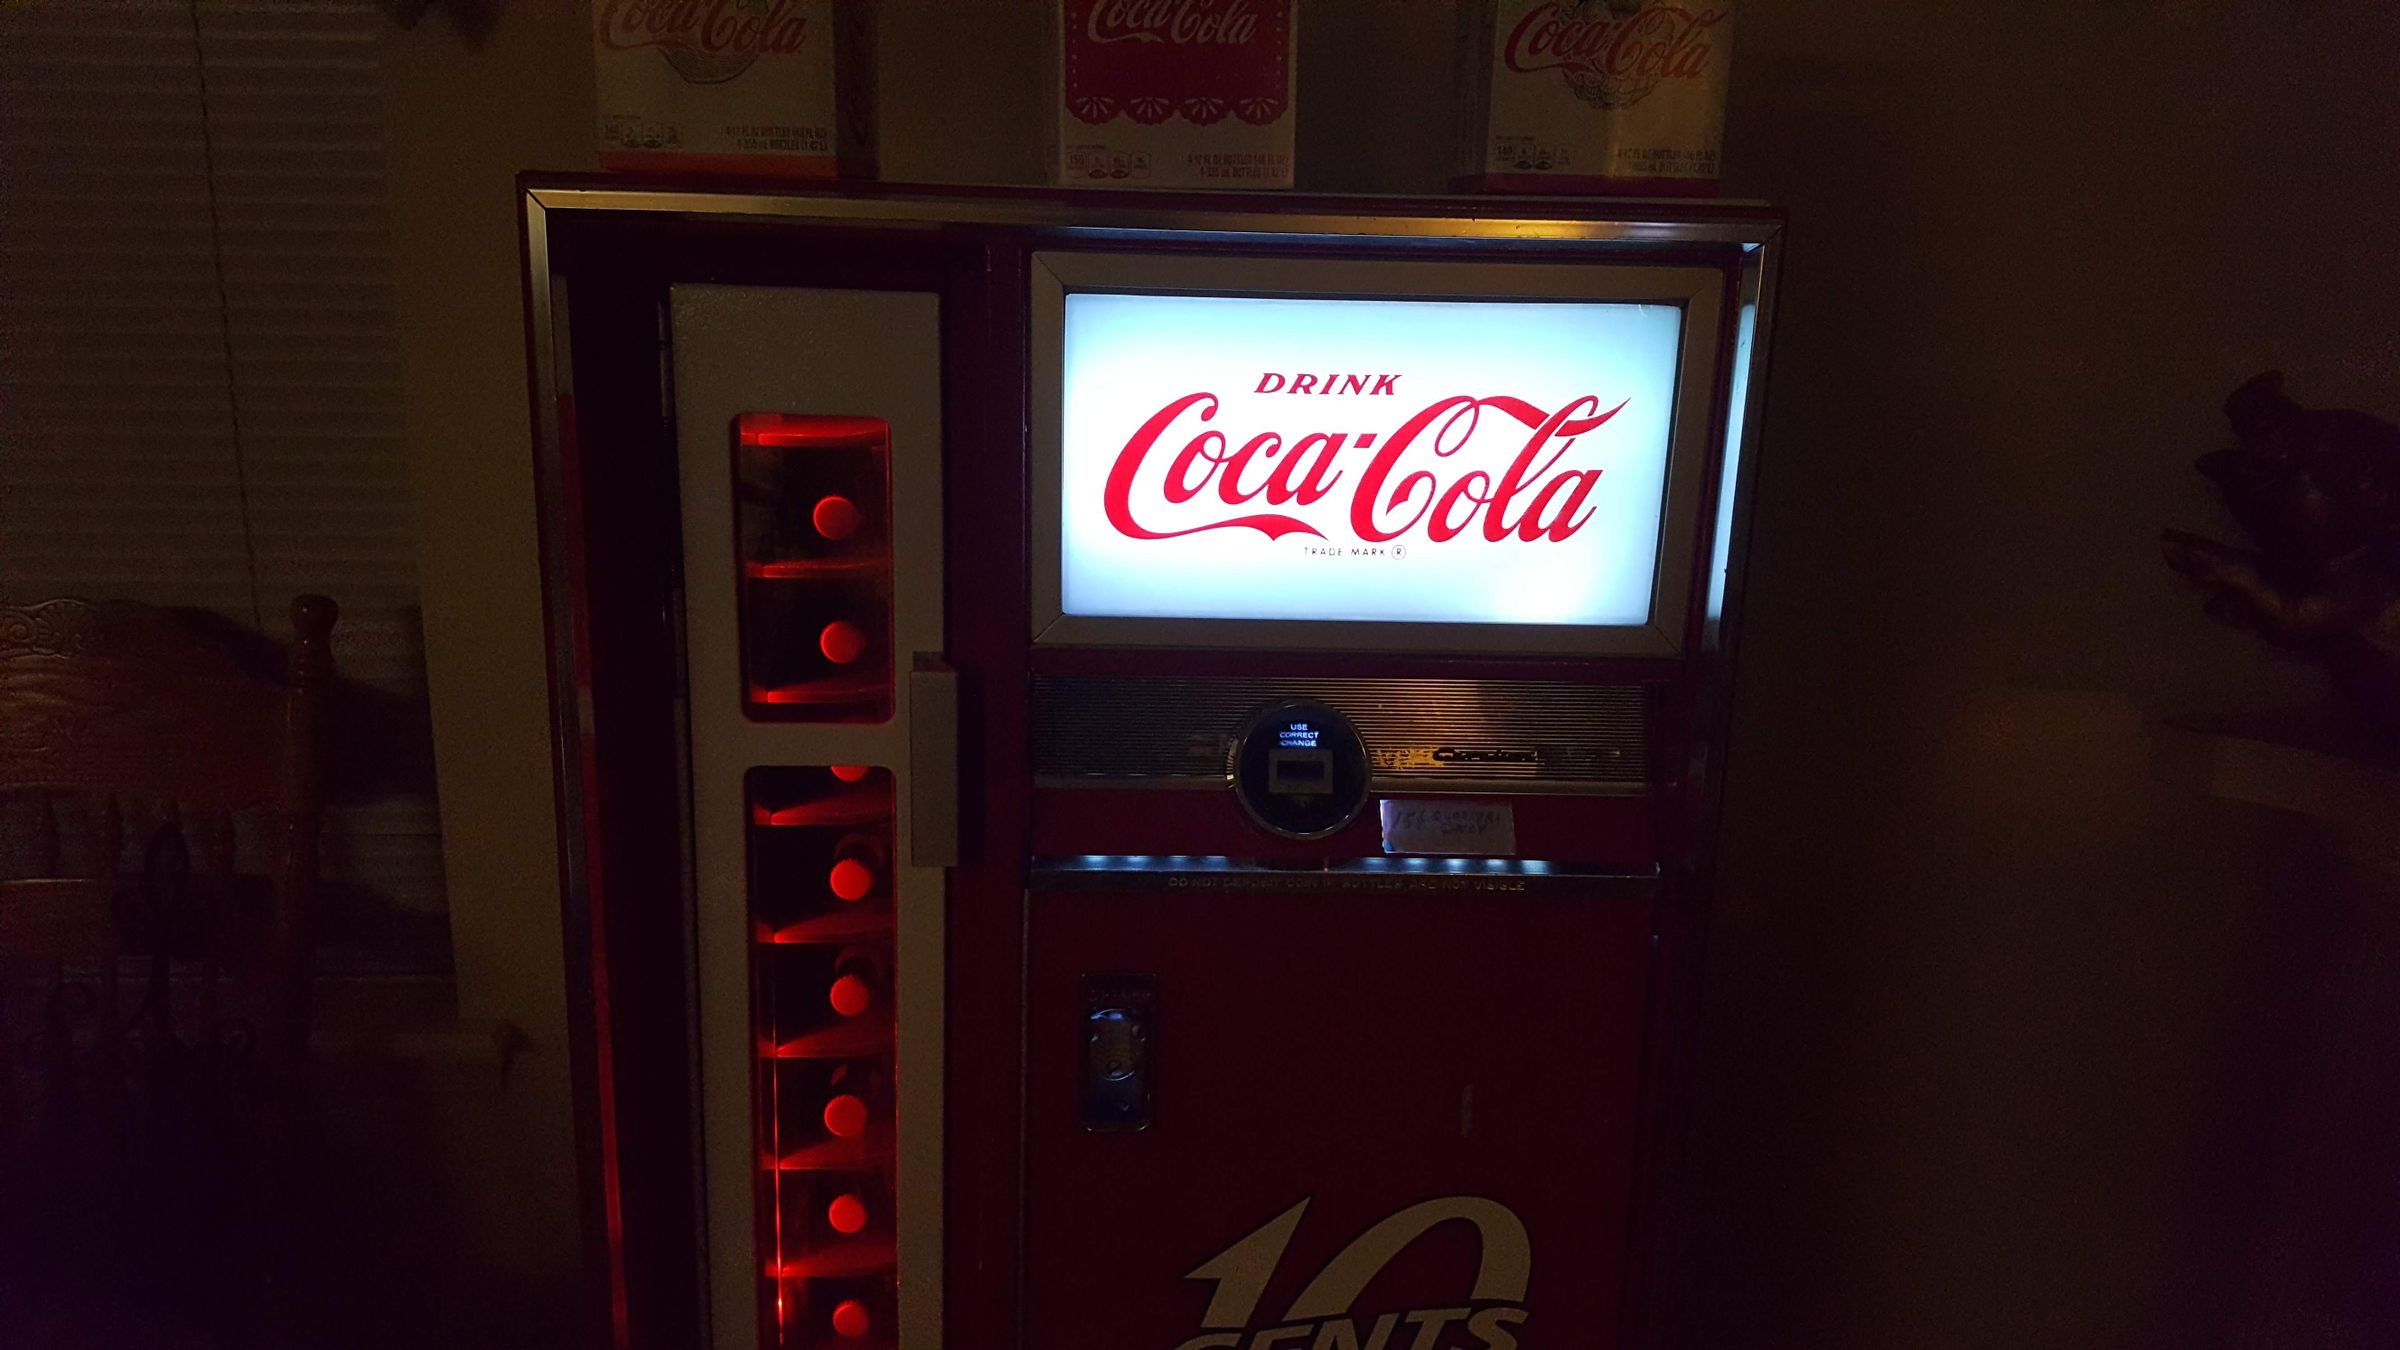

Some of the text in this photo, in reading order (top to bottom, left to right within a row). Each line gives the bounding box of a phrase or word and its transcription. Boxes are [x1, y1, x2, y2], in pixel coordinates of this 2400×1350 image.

[600, 0, 808, 53] CocaCola
[1088, 0, 1259, 44] CocaCola
[1254, 372, 1402, 396] DRINK
[1103, 391, 1632, 543] Coca-Cola
[1304, 547, 1342, 557] TRADE
[1351, 548, 1385, 556] MARK
[1280, 731, 1319, 739] CORRECT
[1290, 723, 1308, 731] USE
[1280, 739, 1317, 747] CHANGE
[1168, 876, 1189, 888] DO
[1183, 1195, 1532, 1329] 10
